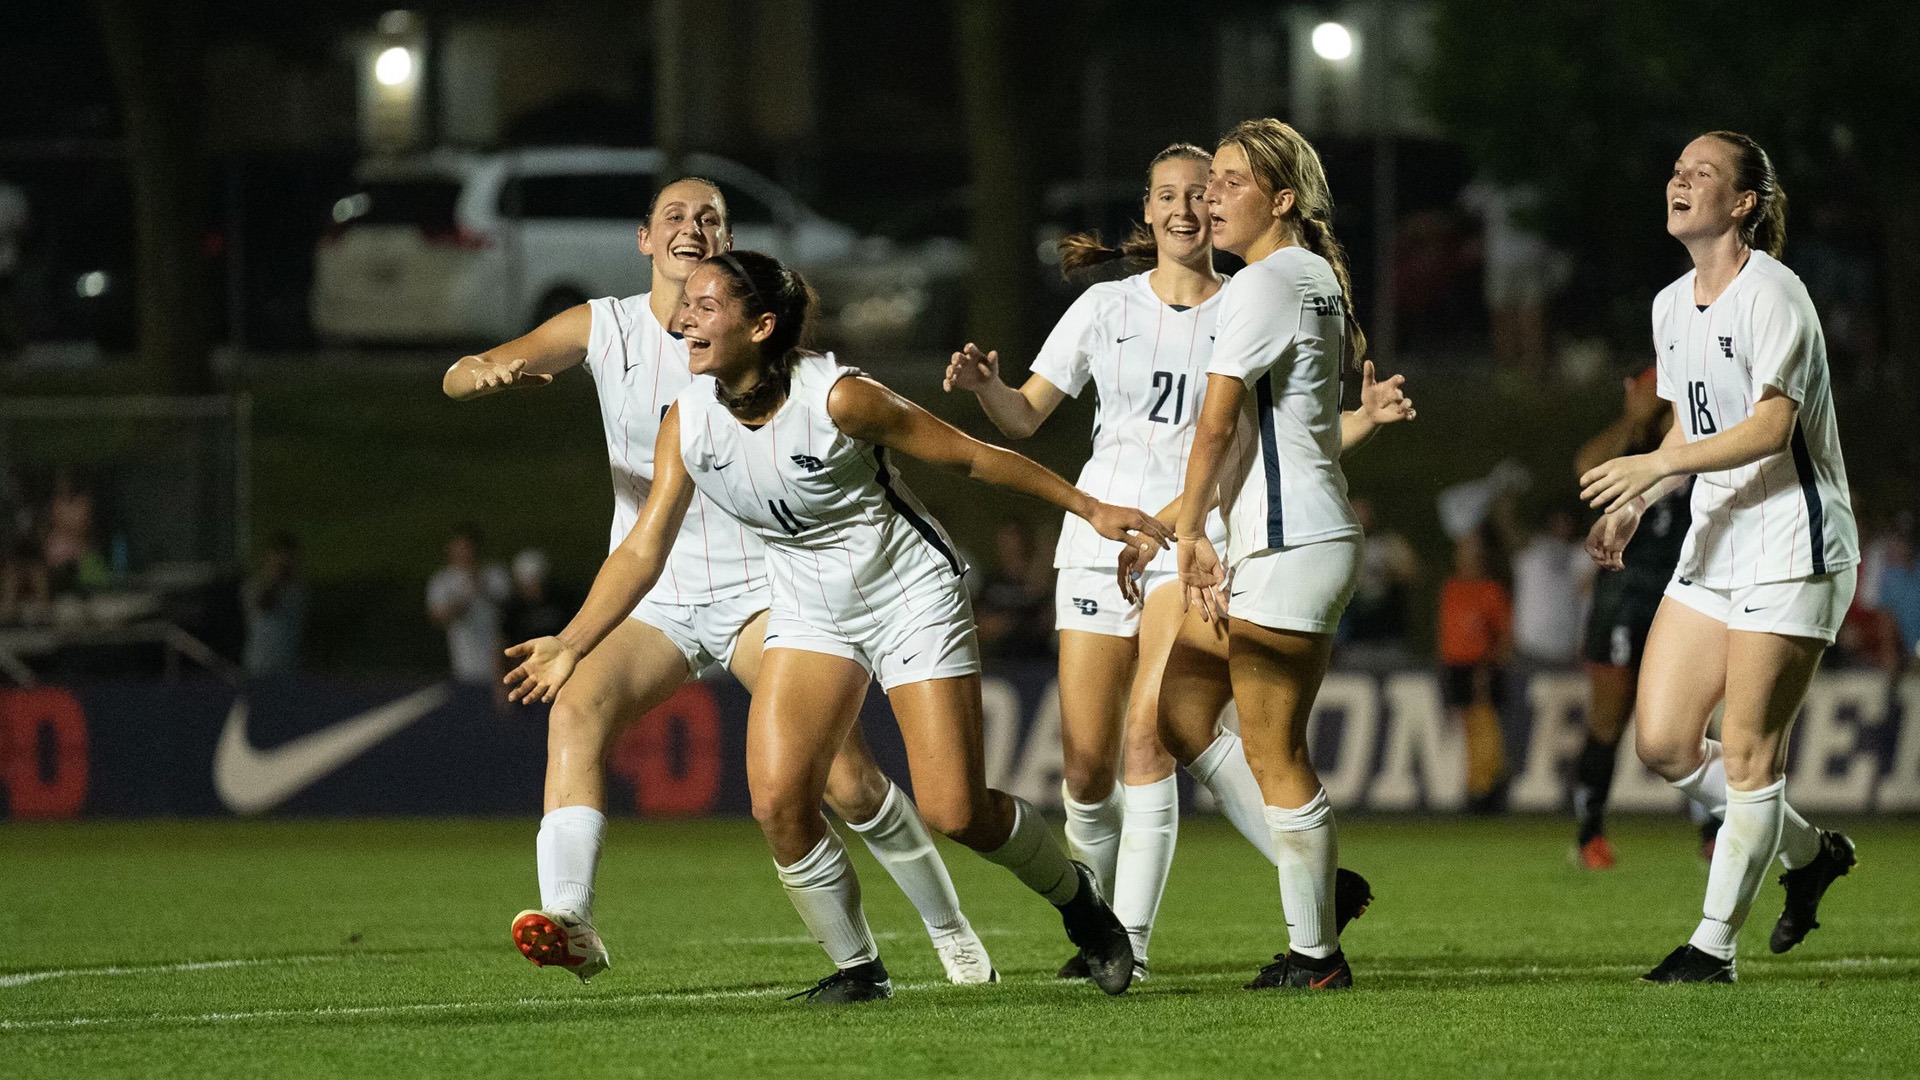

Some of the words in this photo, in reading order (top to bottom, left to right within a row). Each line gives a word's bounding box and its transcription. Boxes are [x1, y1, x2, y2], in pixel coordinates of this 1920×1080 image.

[1148, 370, 1187, 425] 21
[1688, 381, 1717, 435] 18
[768, 499, 810, 537] 11
